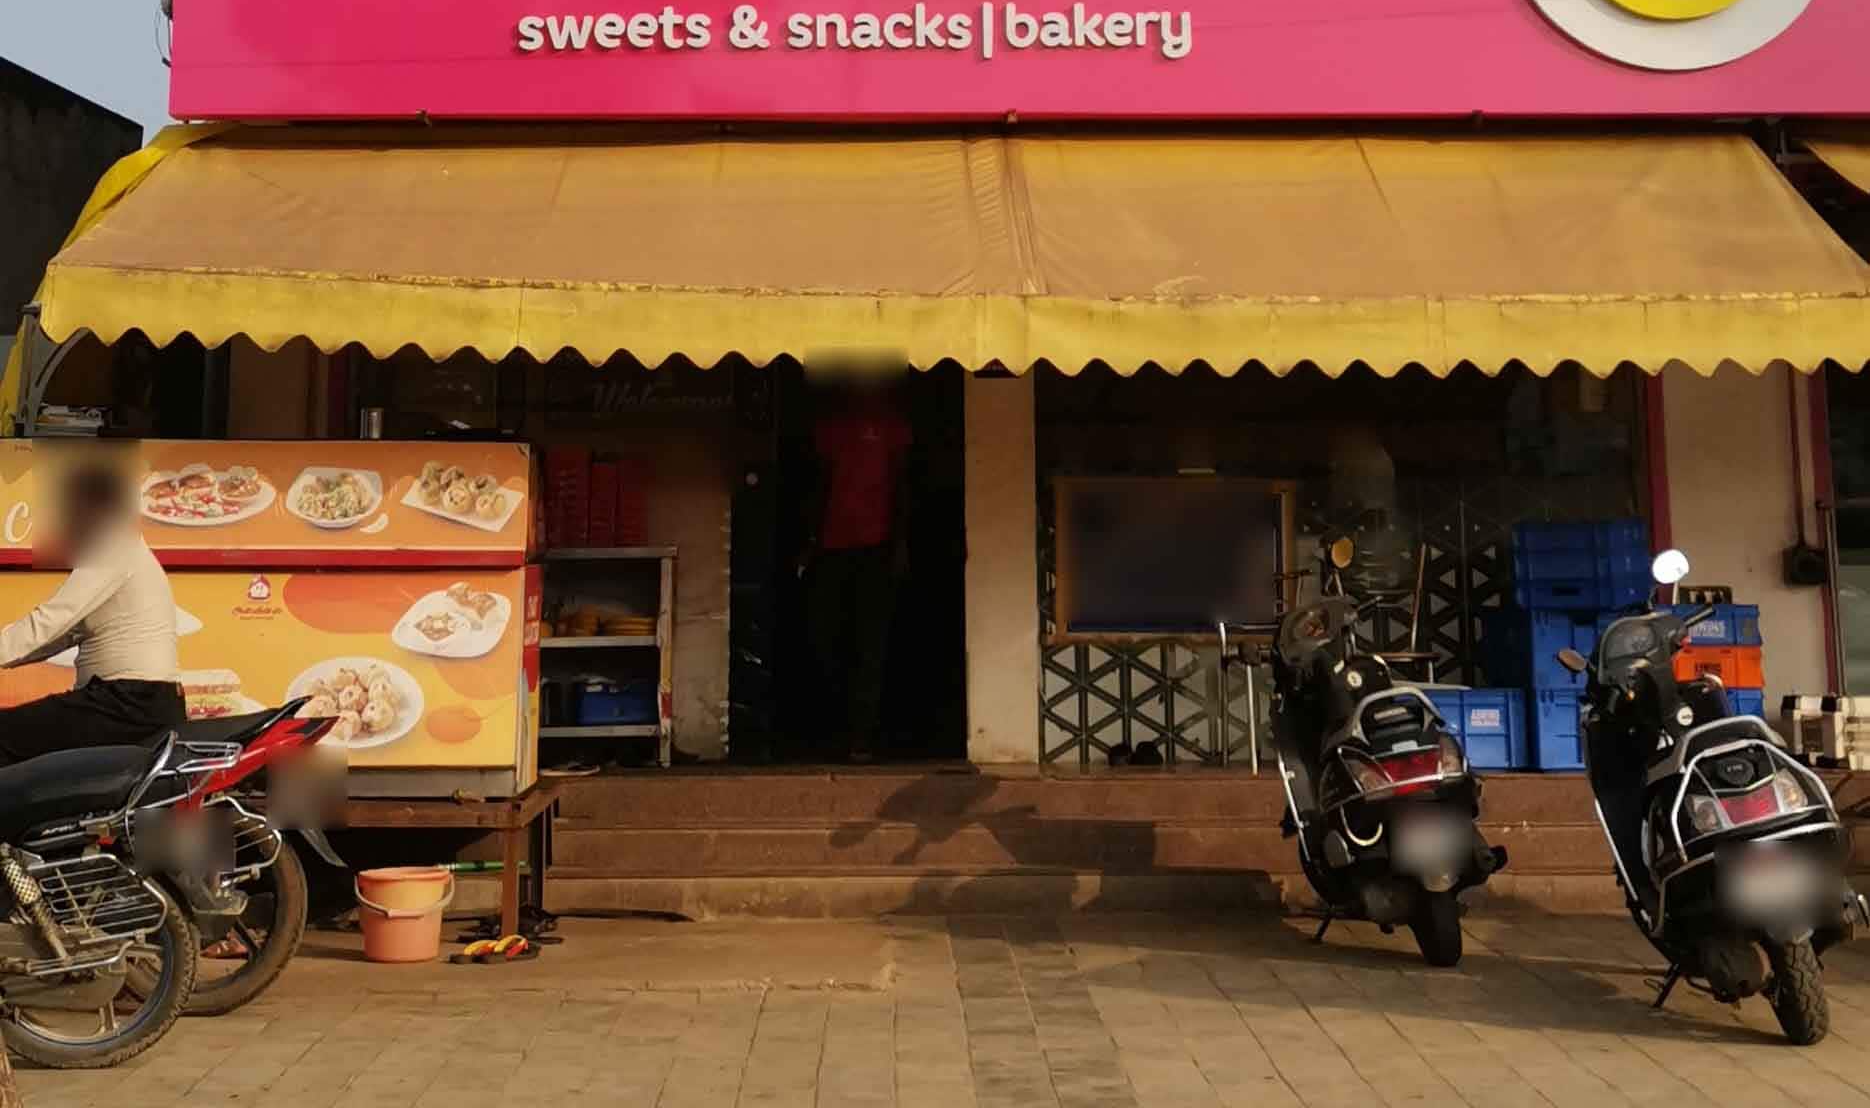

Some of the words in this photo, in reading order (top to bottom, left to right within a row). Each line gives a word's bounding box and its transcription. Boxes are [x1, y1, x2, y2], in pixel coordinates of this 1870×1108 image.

[518, 6, 711, 50] sweets
[729, 5, 770, 48] &
[788, 2, 972, 49] snacks
[1005, 2, 1192, 58] bakery
